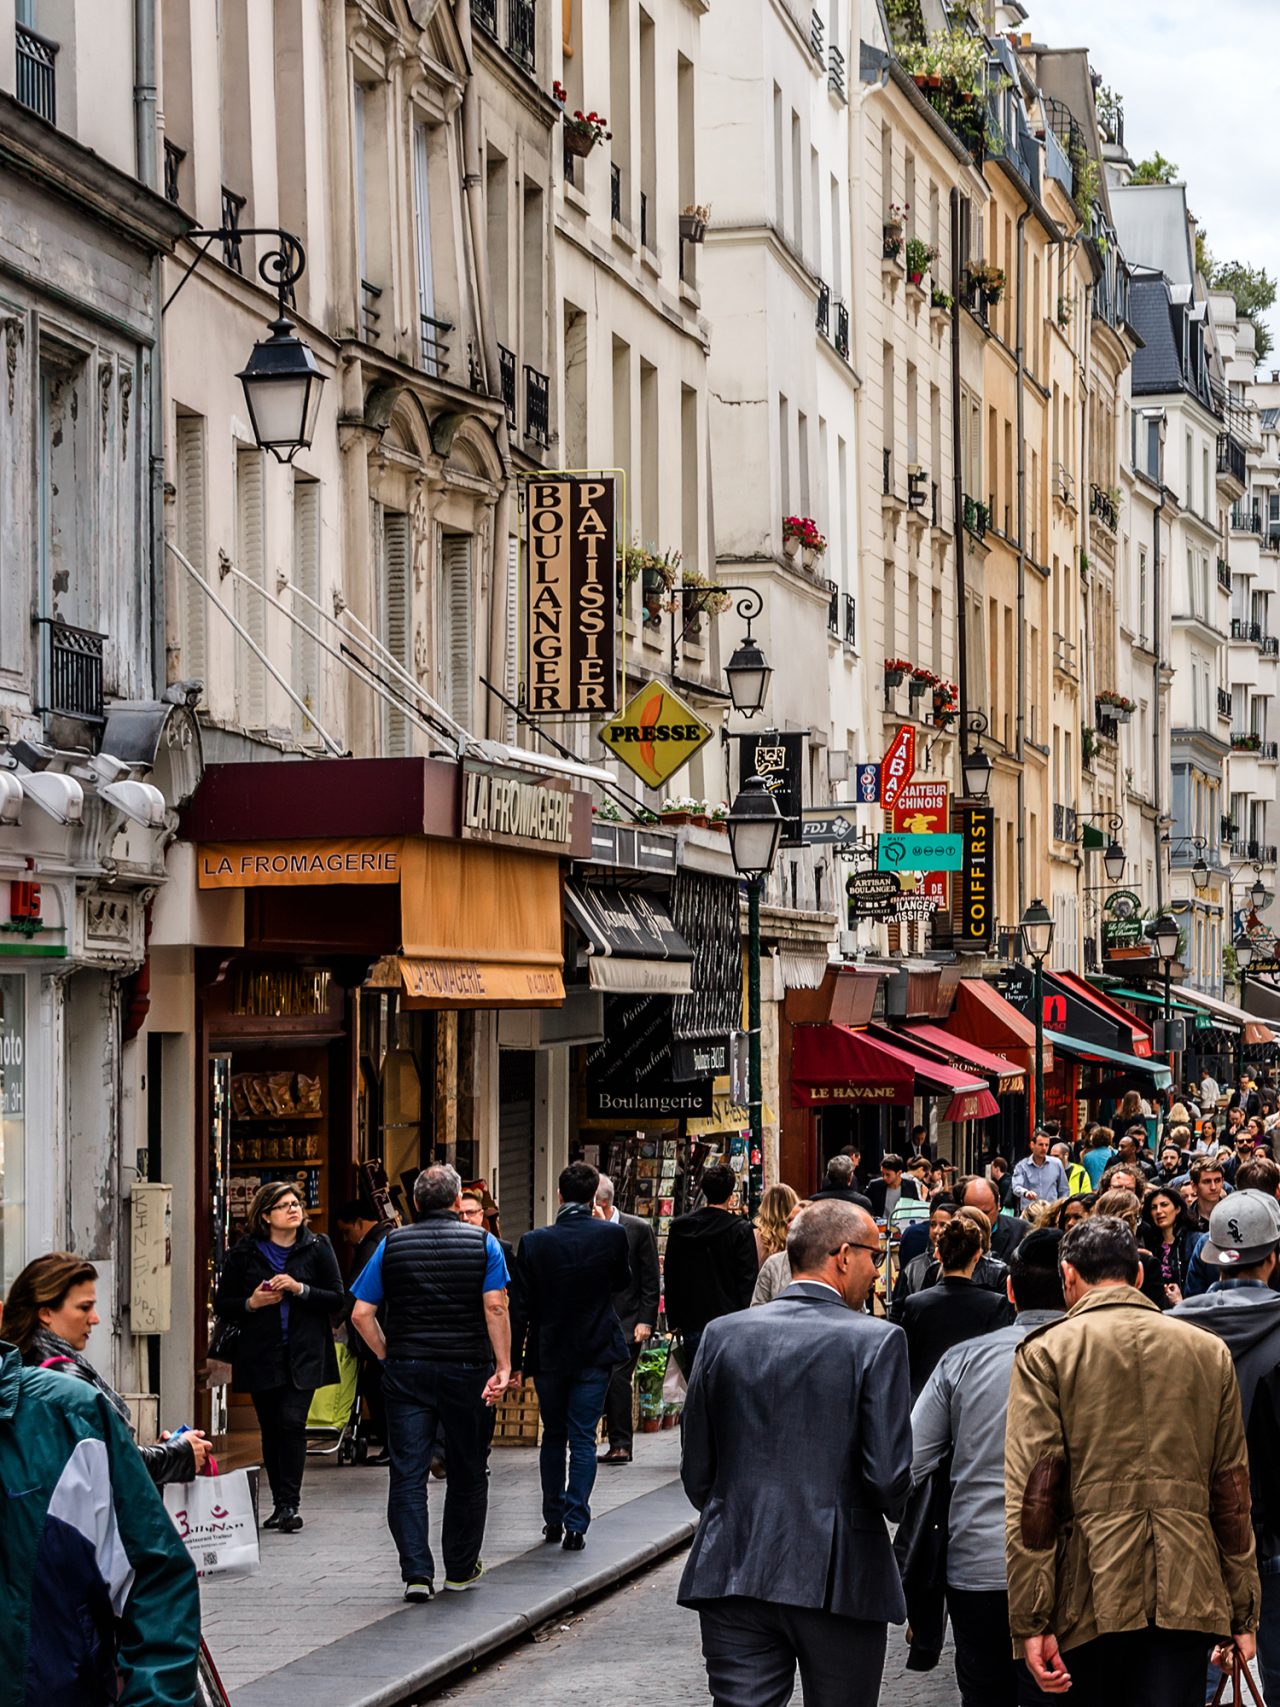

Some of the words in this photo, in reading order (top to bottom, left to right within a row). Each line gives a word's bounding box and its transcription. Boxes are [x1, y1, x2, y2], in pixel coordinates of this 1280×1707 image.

[532, 485, 564, 710] BOULANGER
[577, 483, 607, 709] PATISSIER
[610, 725, 700, 742] PRESSE
[885, 733, 910, 802] TABAC
[902, 784, 946, 797] RAITEUR
[466, 772, 489, 829] LA
[490, 777, 574, 843] FROMAGERIE
[898, 797, 943, 809] CHINOIS
[803, 822, 827, 834] FDJ
[204, 857, 233, 876] LA
[241, 852, 397, 874] FROMAGERIE
[849, 885, 897, 894] BOULANGER
[855, 879, 891, 887] ARTISAN
[931, 883, 943, 895] DE
[1010, 982, 1023, 991] Jeff
[811, 1088, 829, 1099] LE
[833, 1087, 895, 1098] HAVANE
[599, 1093, 703, 1112] Boulangerie
